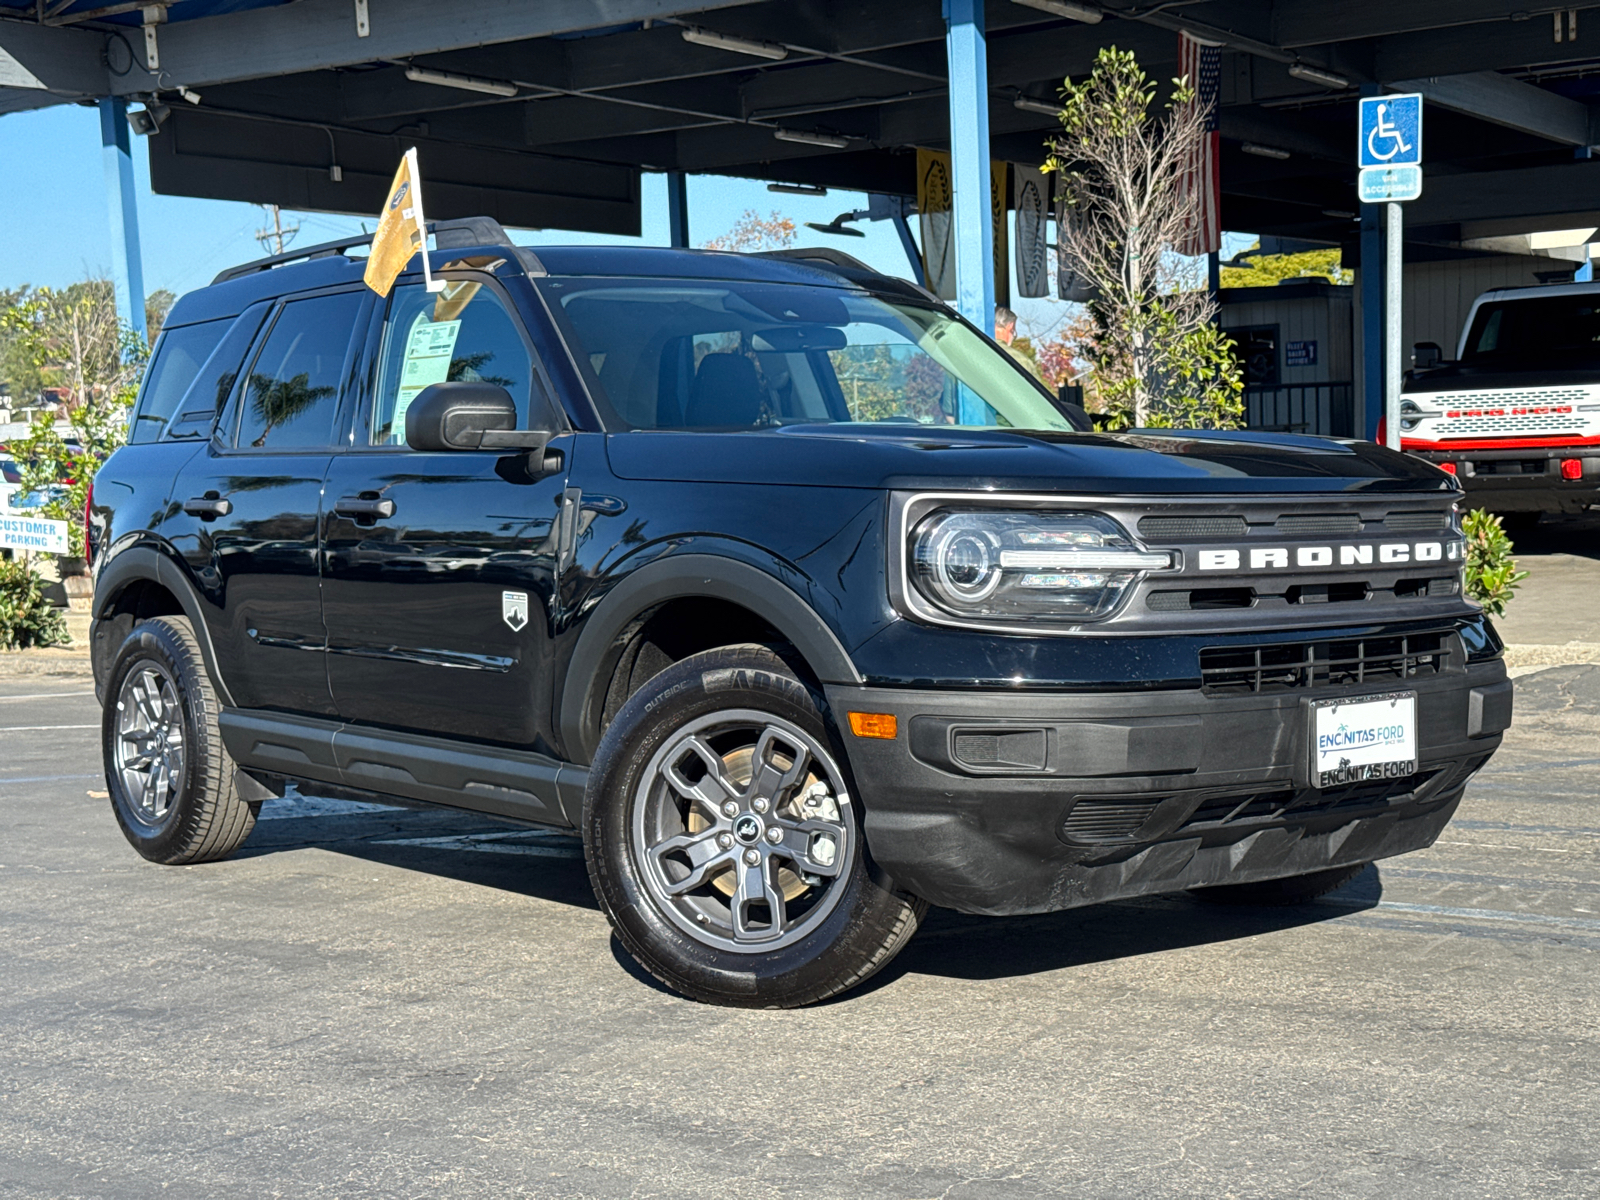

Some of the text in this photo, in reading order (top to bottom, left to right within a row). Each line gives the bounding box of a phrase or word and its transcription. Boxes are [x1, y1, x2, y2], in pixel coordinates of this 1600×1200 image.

[5, 533, 48, 547] PARKING
[1199, 542, 1442, 570] BRONCO
[644, 677, 691, 713] OUTSIDE
[1319, 724, 1404, 748] ENCINITAS FORD
[1320, 760, 1414, 787] ENCINITAS FORD
[594, 817, 621, 905] ALL SEASON
